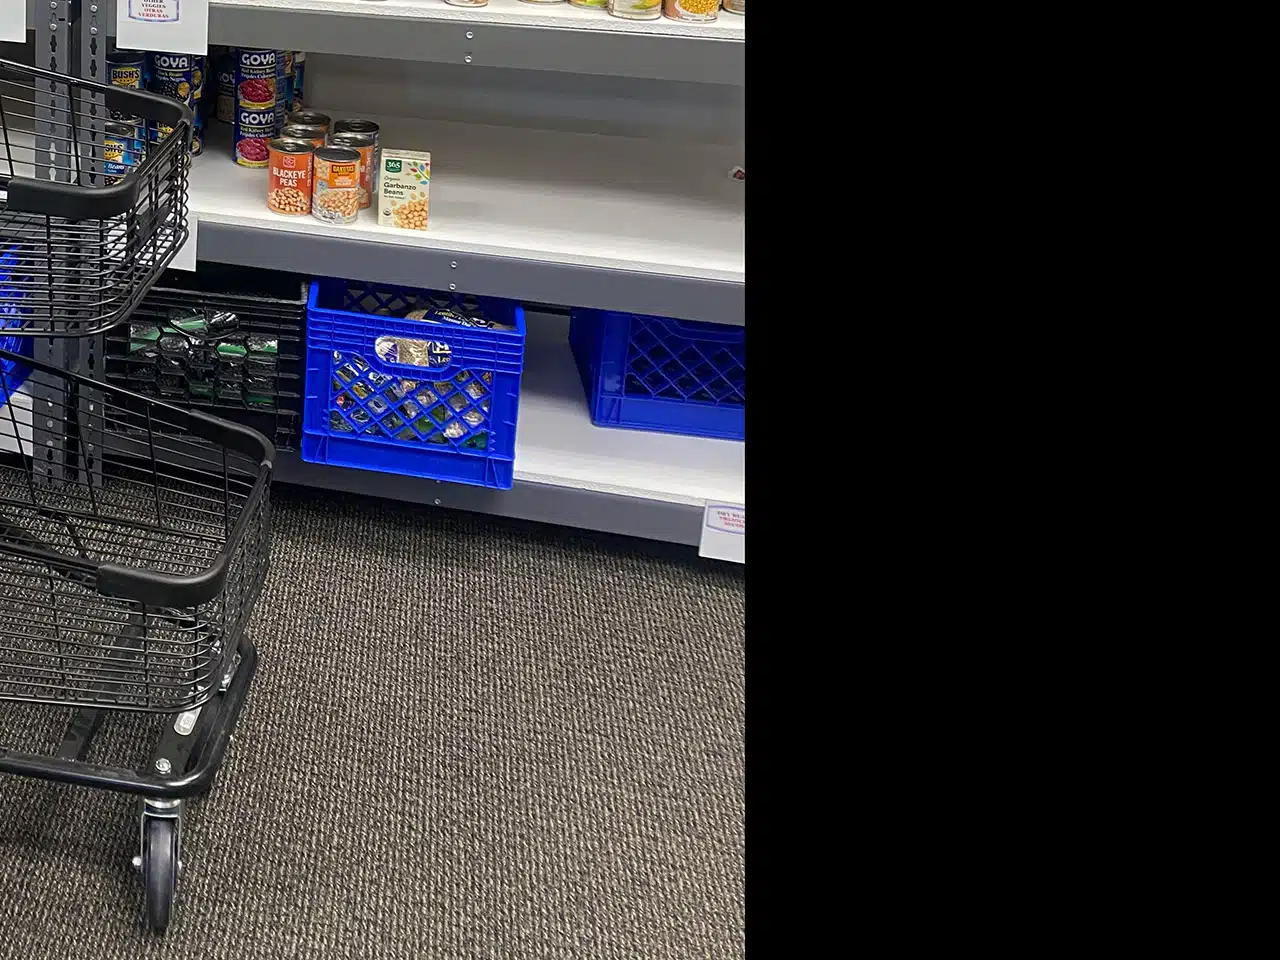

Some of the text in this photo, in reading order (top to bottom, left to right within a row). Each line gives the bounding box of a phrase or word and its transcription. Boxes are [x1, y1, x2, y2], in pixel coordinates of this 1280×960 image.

[155, 55, 188, 68] GOYA
[242, 53, 276, 65] GOYA
[112, 69, 140, 79] BUSH'S
[240, 112, 275, 124] GOYA
[387, 161, 400, 169] 365
[272, 167, 306, 179] BLACKEYE
[279, 178, 298, 187] PEAS
[383, 182, 417, 190] Garbanzo
